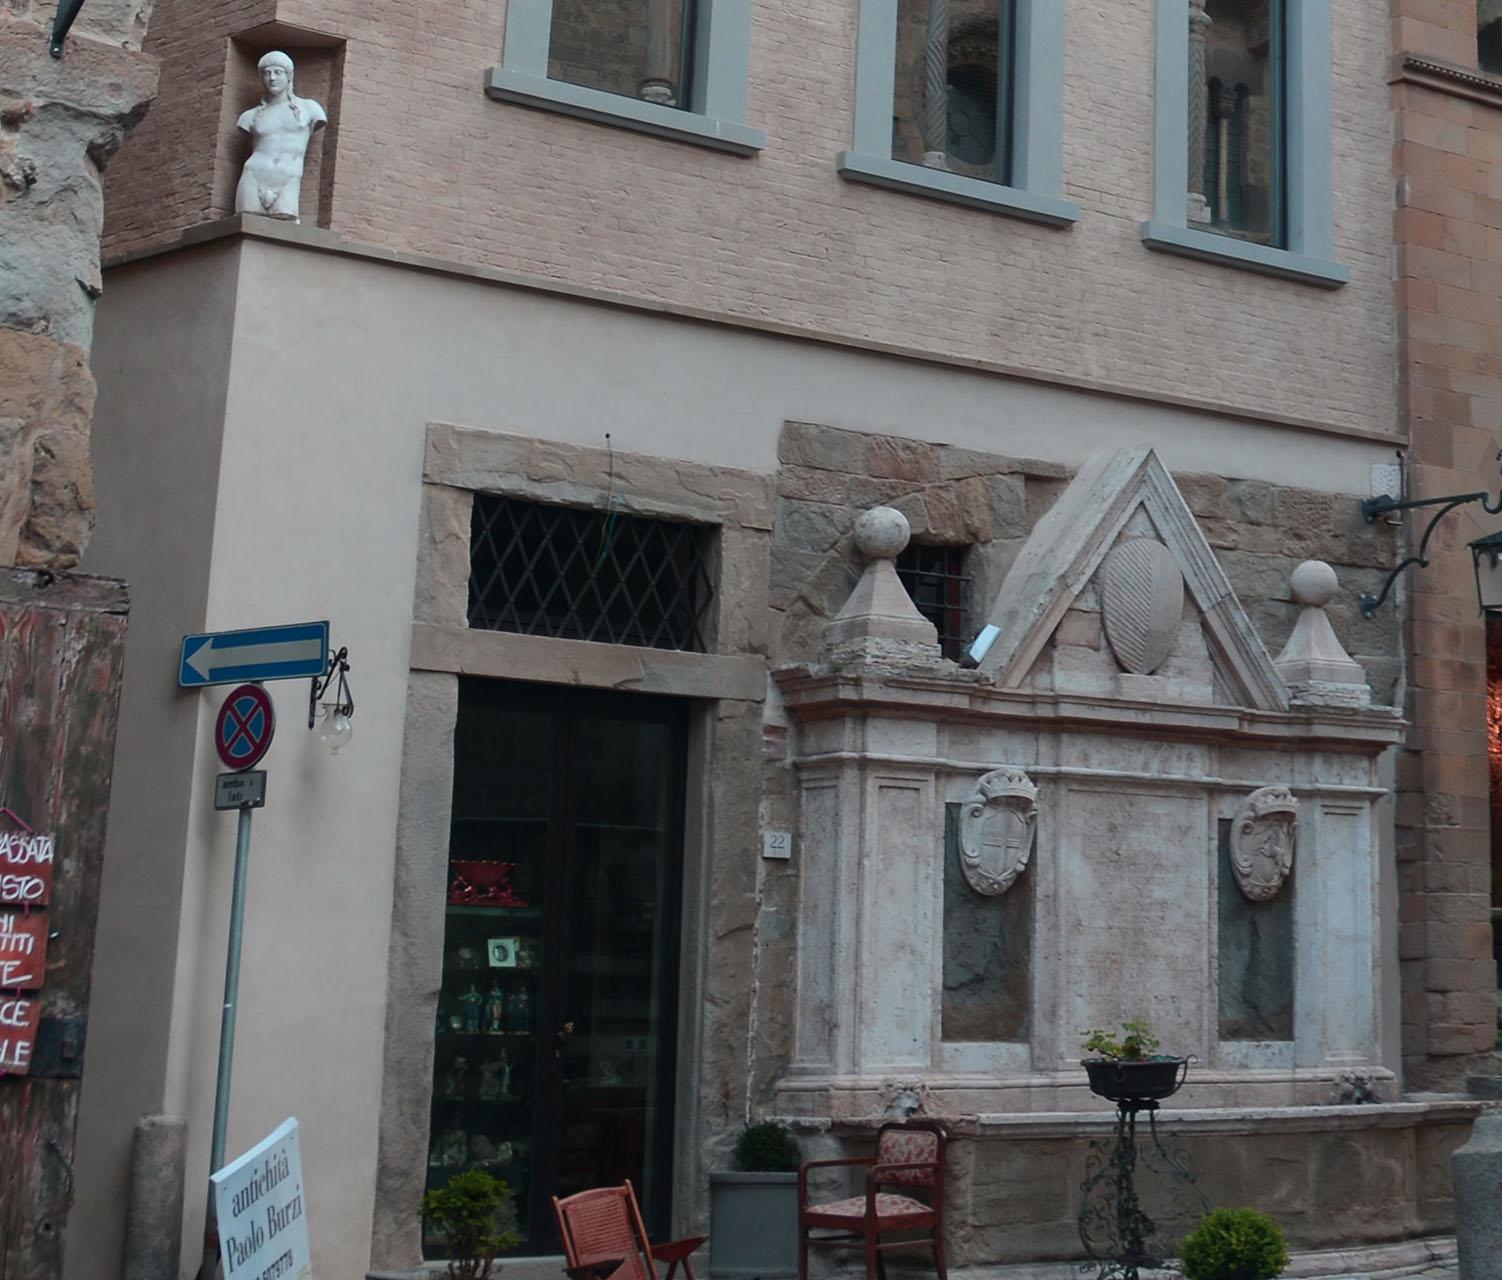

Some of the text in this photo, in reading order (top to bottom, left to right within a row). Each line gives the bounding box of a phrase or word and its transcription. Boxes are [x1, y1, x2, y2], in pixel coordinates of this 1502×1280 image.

[770, 834, 785, 849] 22
[232, 1148, 290, 1218] antichità
[226, 1184, 303, 1273] Paolo Burzi
